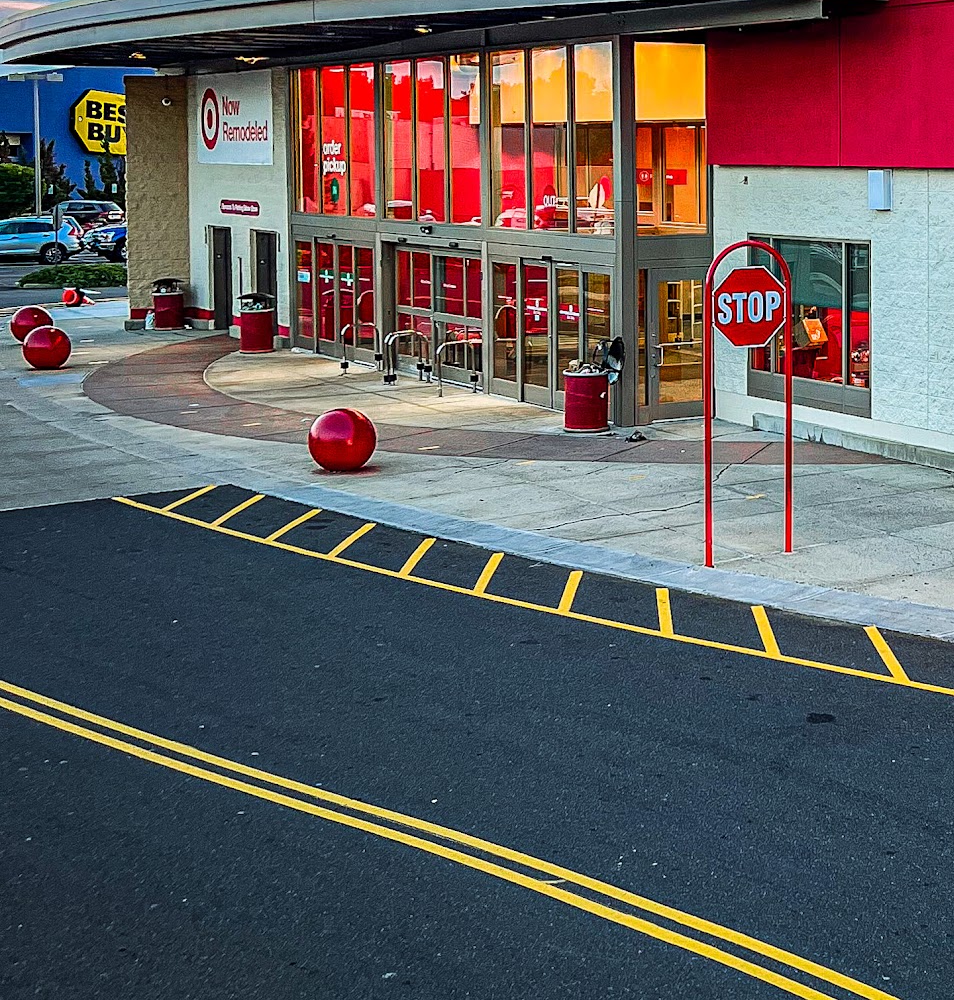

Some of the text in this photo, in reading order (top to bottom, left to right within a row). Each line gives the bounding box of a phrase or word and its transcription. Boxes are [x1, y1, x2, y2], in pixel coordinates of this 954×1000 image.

[86, 100, 126, 124] BES
[222, 96, 240, 115] Now
[88, 123, 126, 143] BU
[222, 120, 268, 141] Remodeled
[323, 140, 341, 155] order
[323, 157, 346, 176] pickup
[717, 290, 781, 325] STOP
